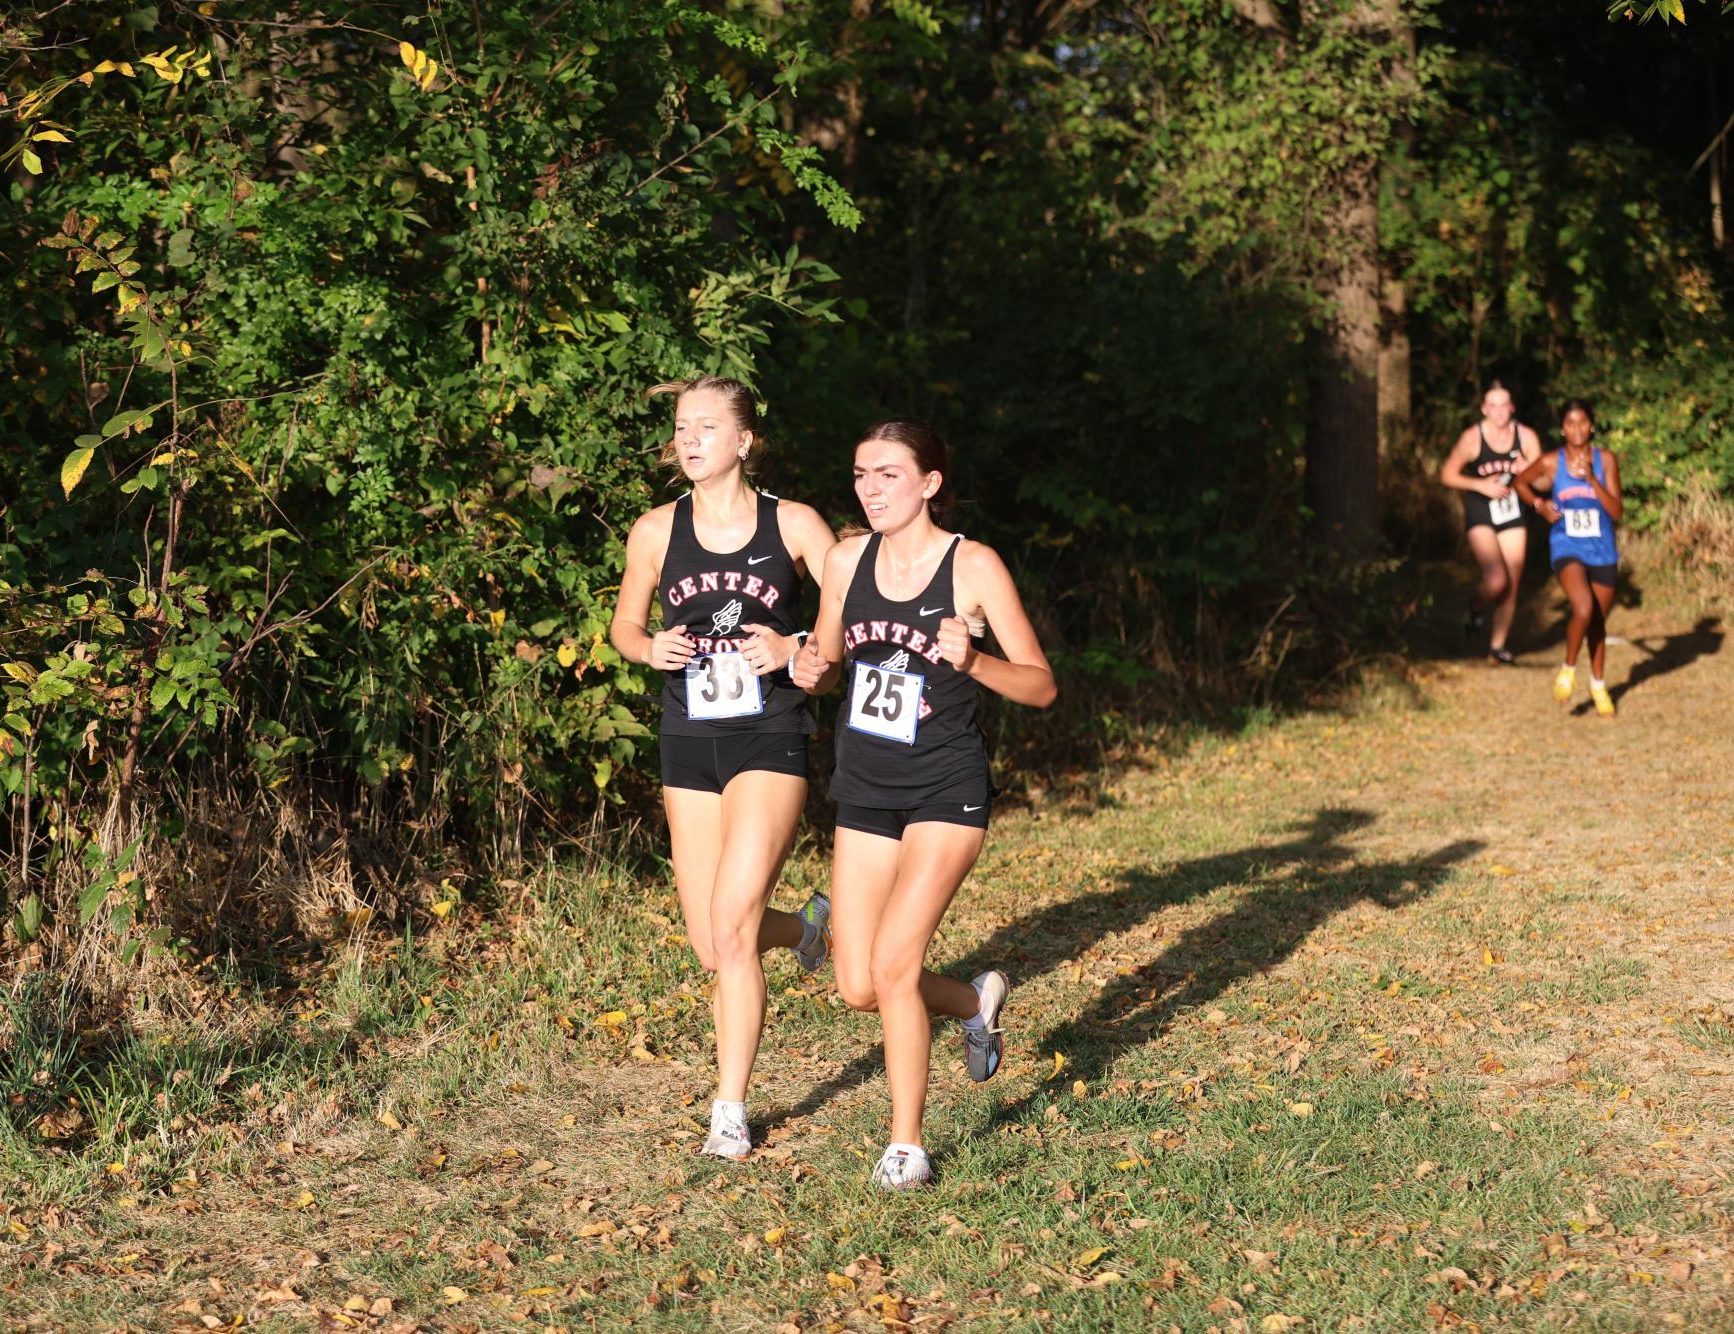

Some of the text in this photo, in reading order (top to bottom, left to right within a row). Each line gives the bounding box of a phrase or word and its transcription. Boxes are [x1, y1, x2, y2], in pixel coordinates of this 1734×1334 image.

[668, 571, 780, 608] CENTER
[845, 620, 943, 664] CENTER
[861, 669, 906, 722] 25
